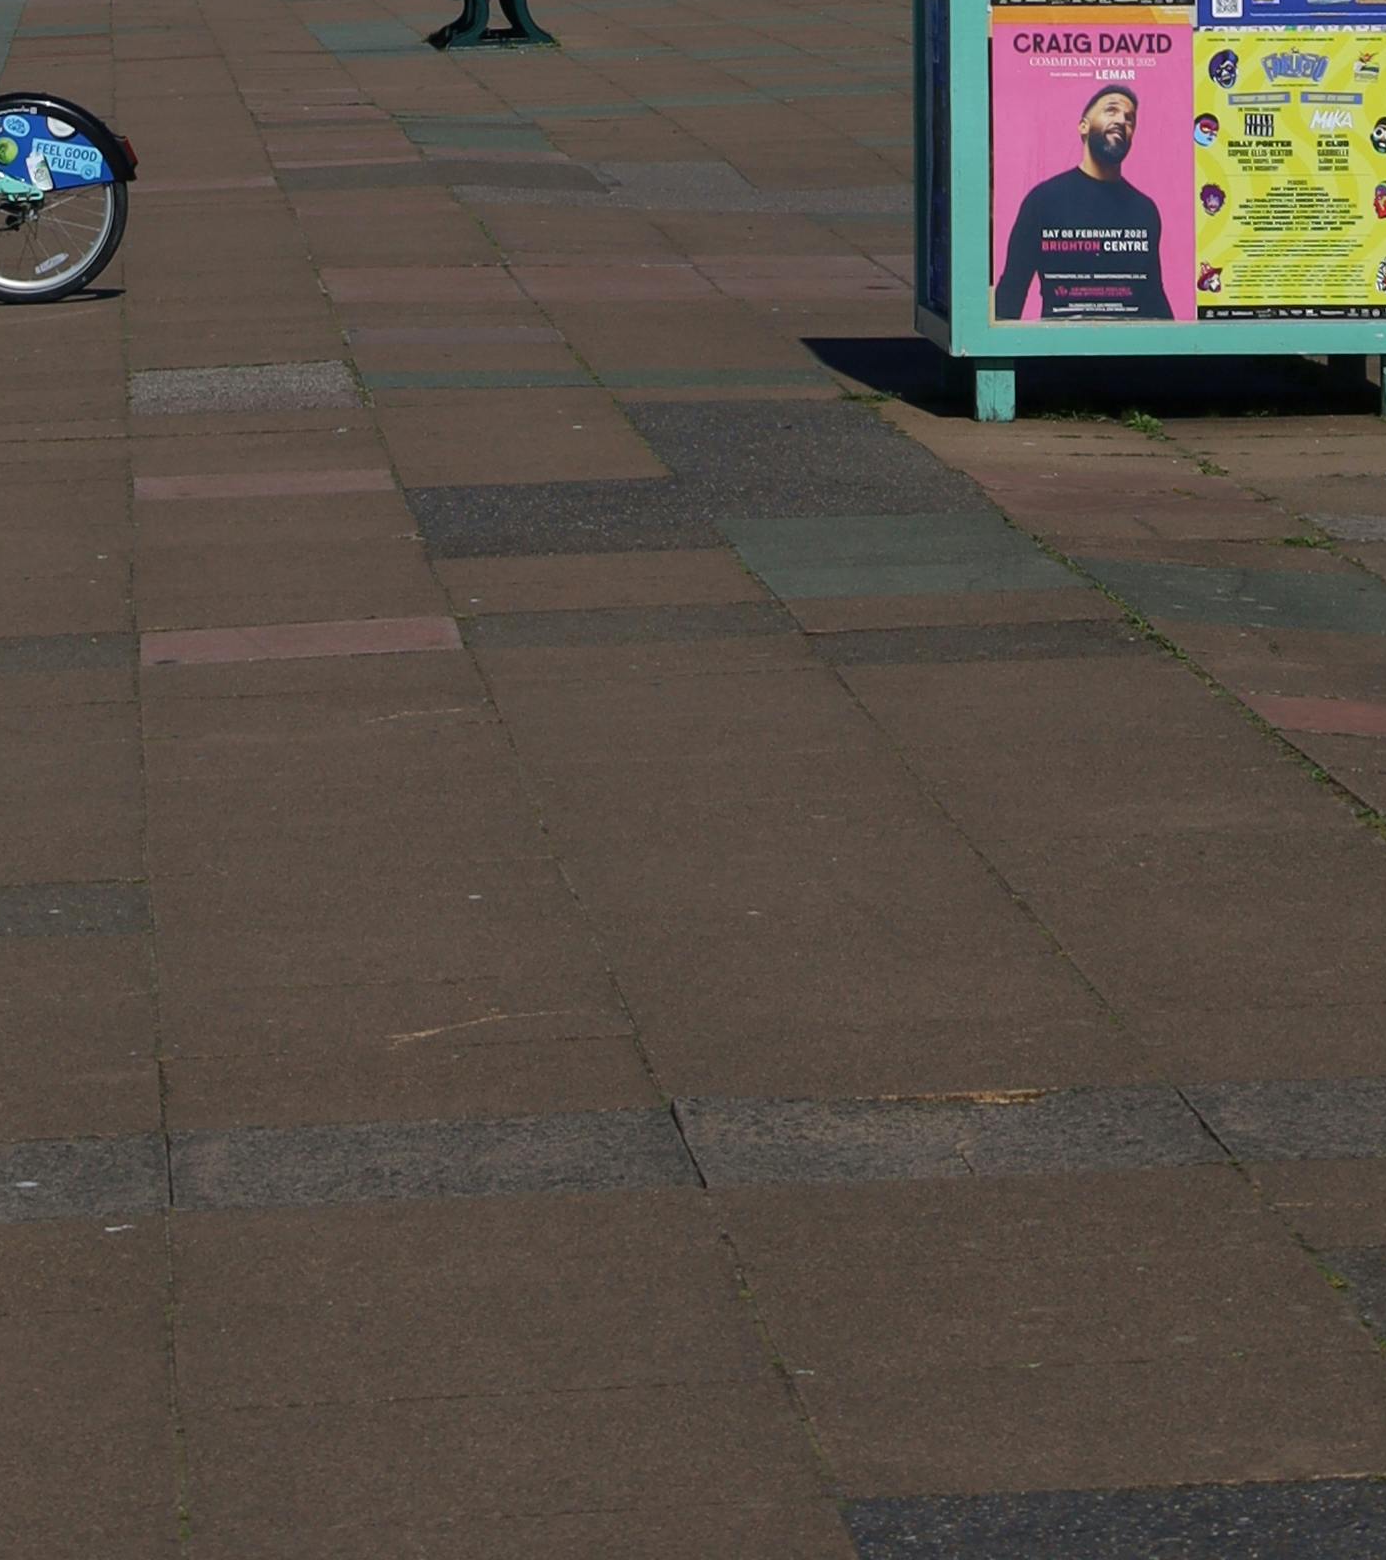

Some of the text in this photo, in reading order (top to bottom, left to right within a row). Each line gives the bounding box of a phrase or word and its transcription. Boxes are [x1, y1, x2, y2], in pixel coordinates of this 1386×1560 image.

[1013, 33, 1173, 54] CRAIG DAVID
[1029, 56, 1157, 68] COMMITMENT TOUR 2025
[1095, 70, 1136, 80] LEMAR
[1310, 109, 1353, 131] MIKA
[36, 142, 98, 162] FEEL GOOD
[51, 157, 78, 172] FUEL
[1042, 229, 1148, 239] SAT 08 FEBRUARY 2025
[1041, 241, 1149, 252] BRIGHTON CENTRE
